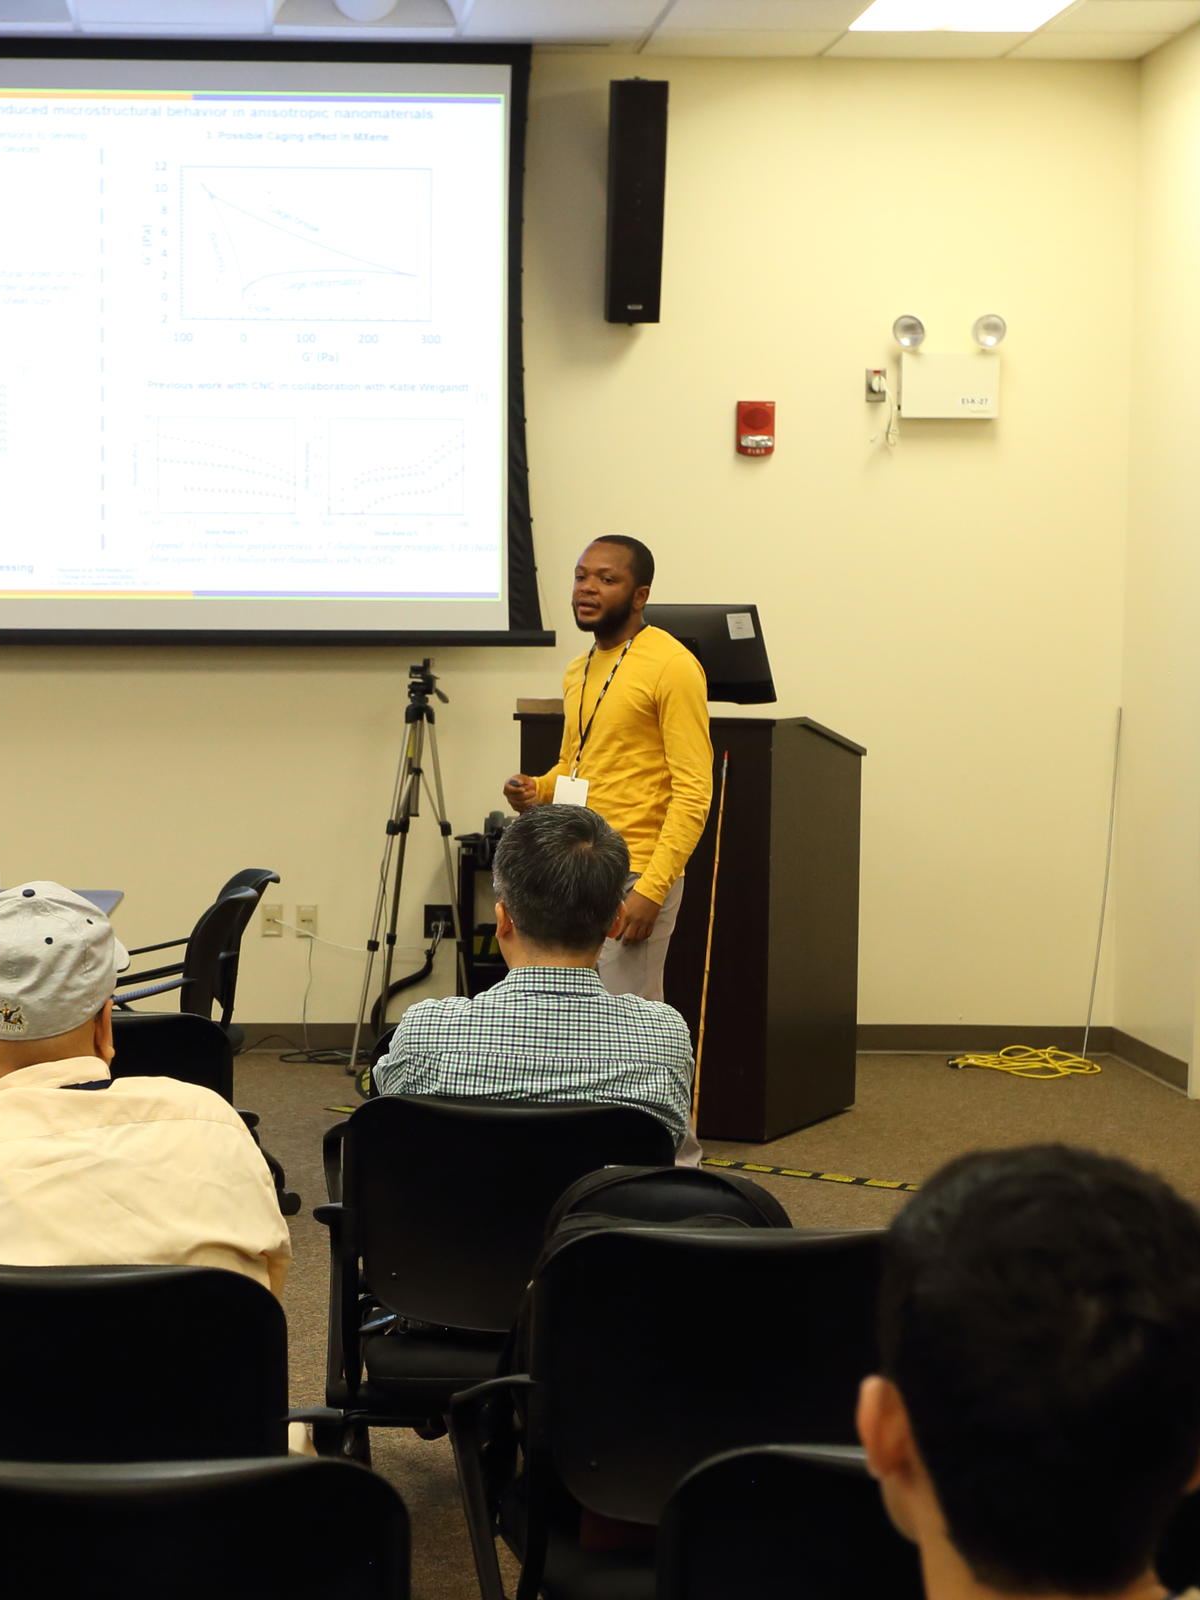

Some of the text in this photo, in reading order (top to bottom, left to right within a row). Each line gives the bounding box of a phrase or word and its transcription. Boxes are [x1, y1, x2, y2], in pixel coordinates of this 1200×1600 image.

[53, 104, 162, 117] microstructural
[166, 106, 228, 118] behavior
[232, 106, 245, 118] in
[249, 106, 329, 121] anisotropic
[334, 108, 435, 120] nanomaterials
[218, 130, 264, 141] Possible
[267, 130, 305, 144] Caging
[295, 332, 318, 345] 100
[357, 333, 380, 345] 200
[146, 379, 194, 391] Previous
[197, 382, 223, 392] work
[225, 381, 250, 392] with
[291, 382, 361, 393] collaboration
[363, 382, 387, 393] with
[388, 383, 417, 394] Katie
